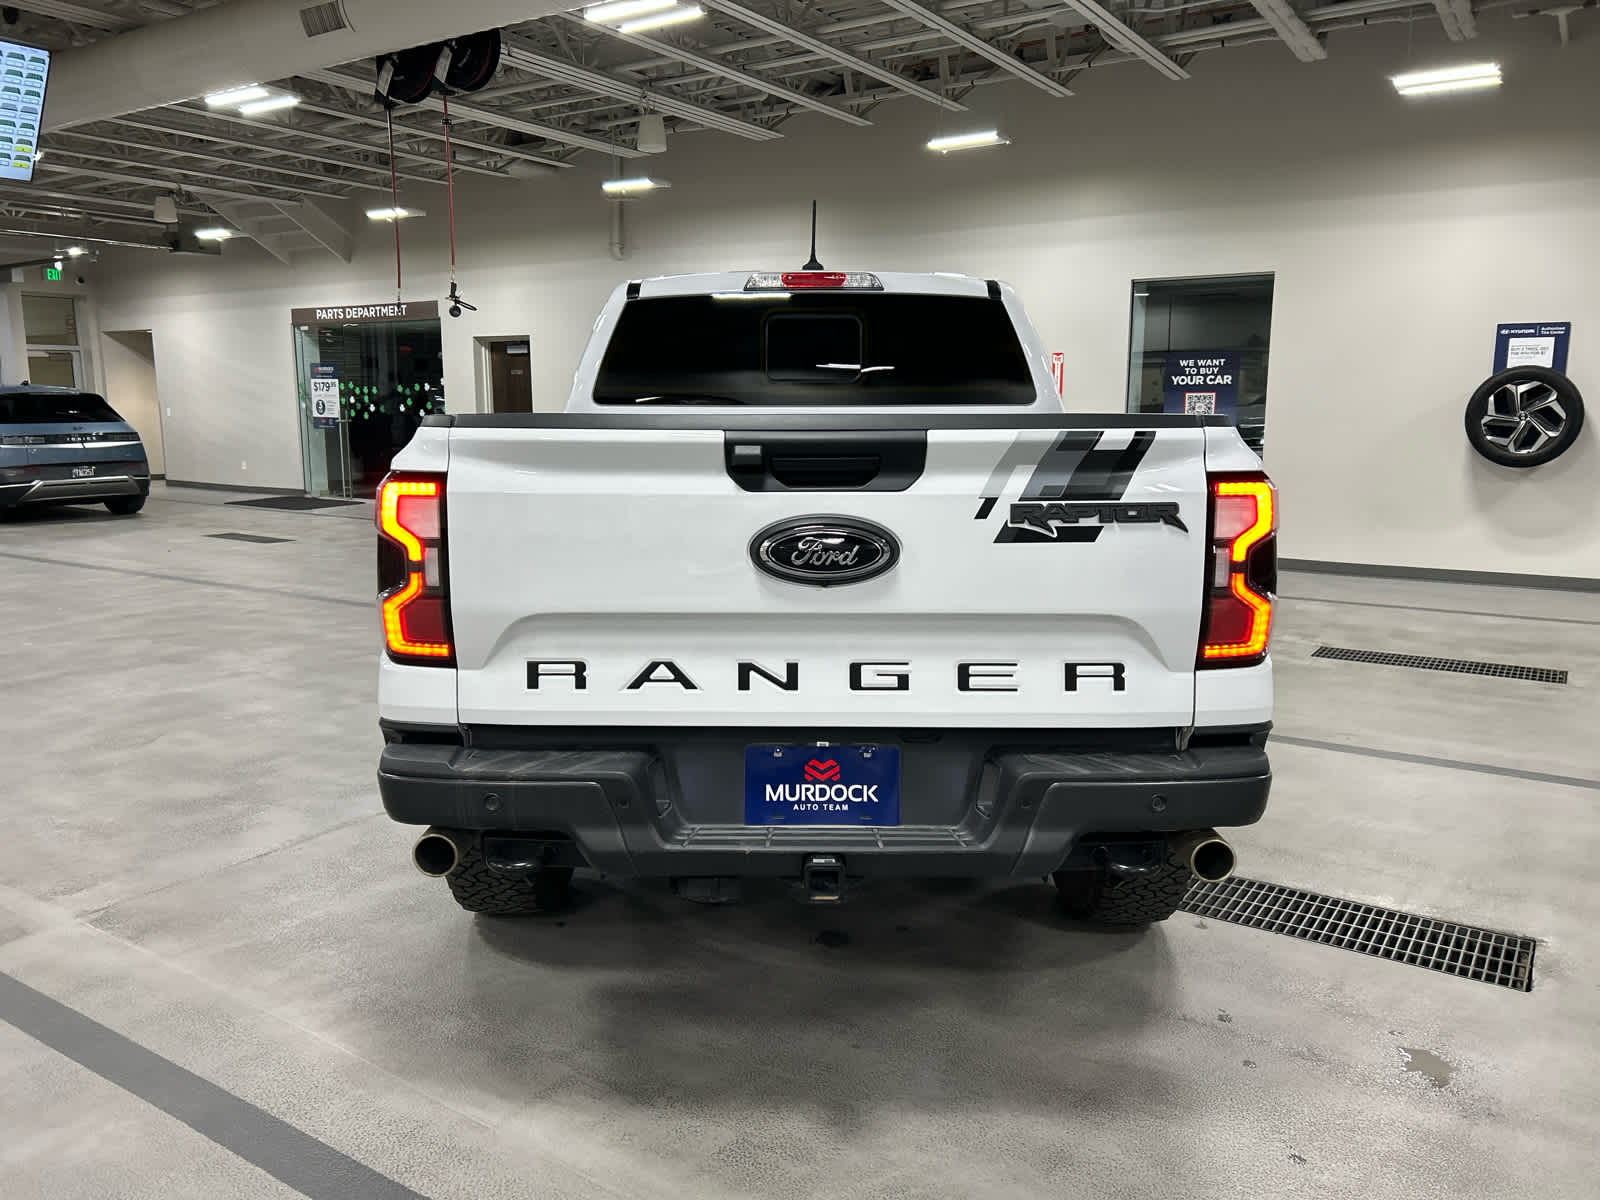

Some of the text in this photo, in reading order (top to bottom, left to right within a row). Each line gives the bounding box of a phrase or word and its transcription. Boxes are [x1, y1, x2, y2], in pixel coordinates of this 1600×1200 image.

[316, 304, 407, 320] PARTS DEPARTMENT
[1179, 358, 1226, 367] WE WANT
[1185, 367, 1219, 375] TO BUY
[1171, 375, 1233, 385] YOUR CAR
[1009, 501, 1189, 534] RAPTOR
[790, 536, 860, 566] Ford
[525, 660, 1126, 692] RANGER
[765, 783, 879, 802] MURDOCK
[792, 803, 849, 811] AUTO TEAM
